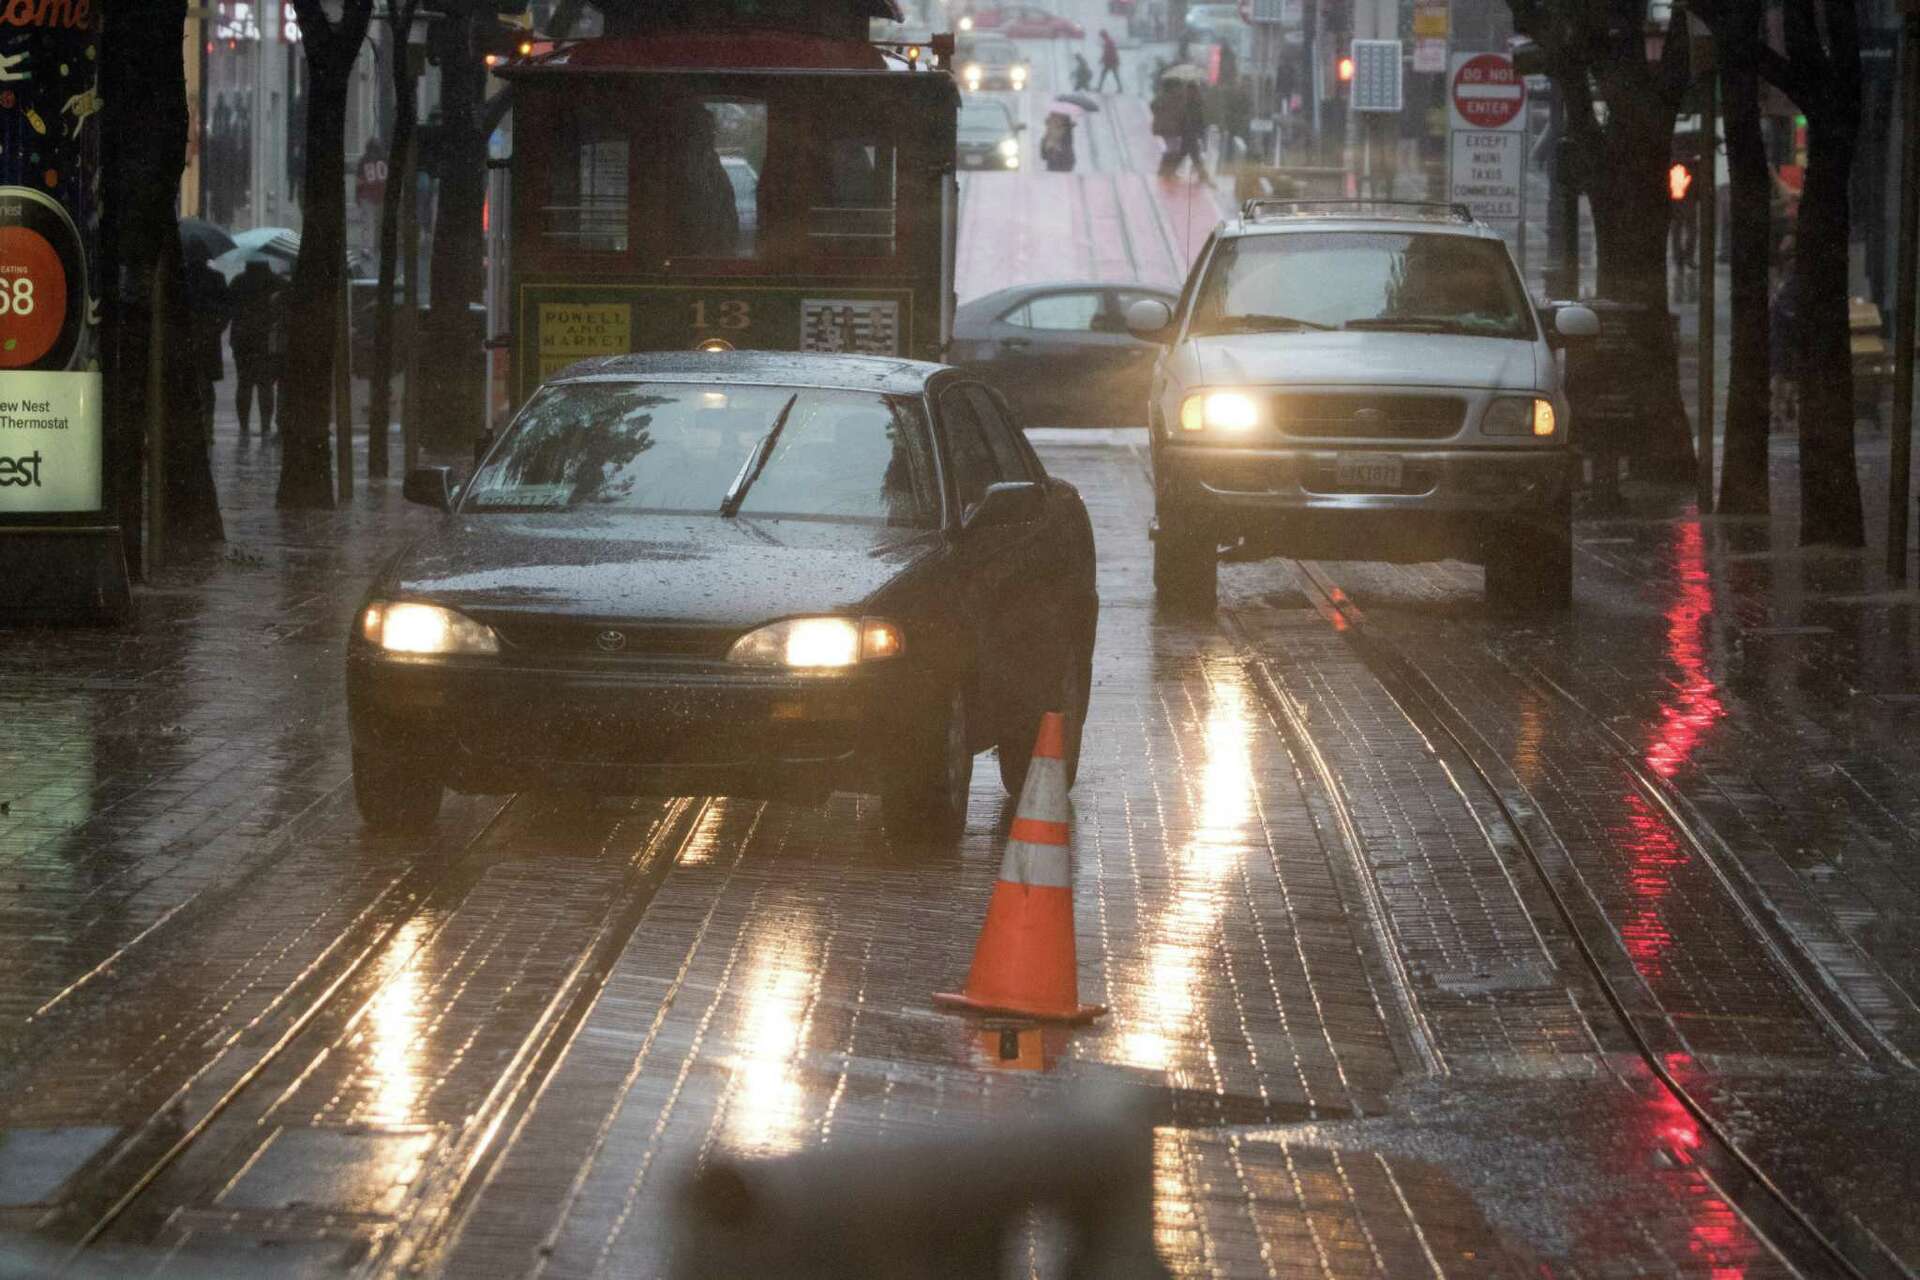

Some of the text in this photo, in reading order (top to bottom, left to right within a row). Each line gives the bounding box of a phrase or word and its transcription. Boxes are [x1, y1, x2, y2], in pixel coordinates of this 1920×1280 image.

[1463, 68, 1514, 81] DO NOT
[1466, 102, 1509, 114] ENTER
[1466, 135, 1508, 147] EXCEPT
[1472, 152, 1501, 164] MUNI
[1471, 168, 1503, 180] TAXIS
[1454, 185, 1518, 197] COMMERCIAL
[545, 311, 625, 324] POWELL
[690, 300, 750, 329] 13
[566, 325, 605, 335] AND
[544, 335, 625, 347] MARKET
[22, 400, 50, 412] Nest
[0, 415, 69, 429] Thermostat
